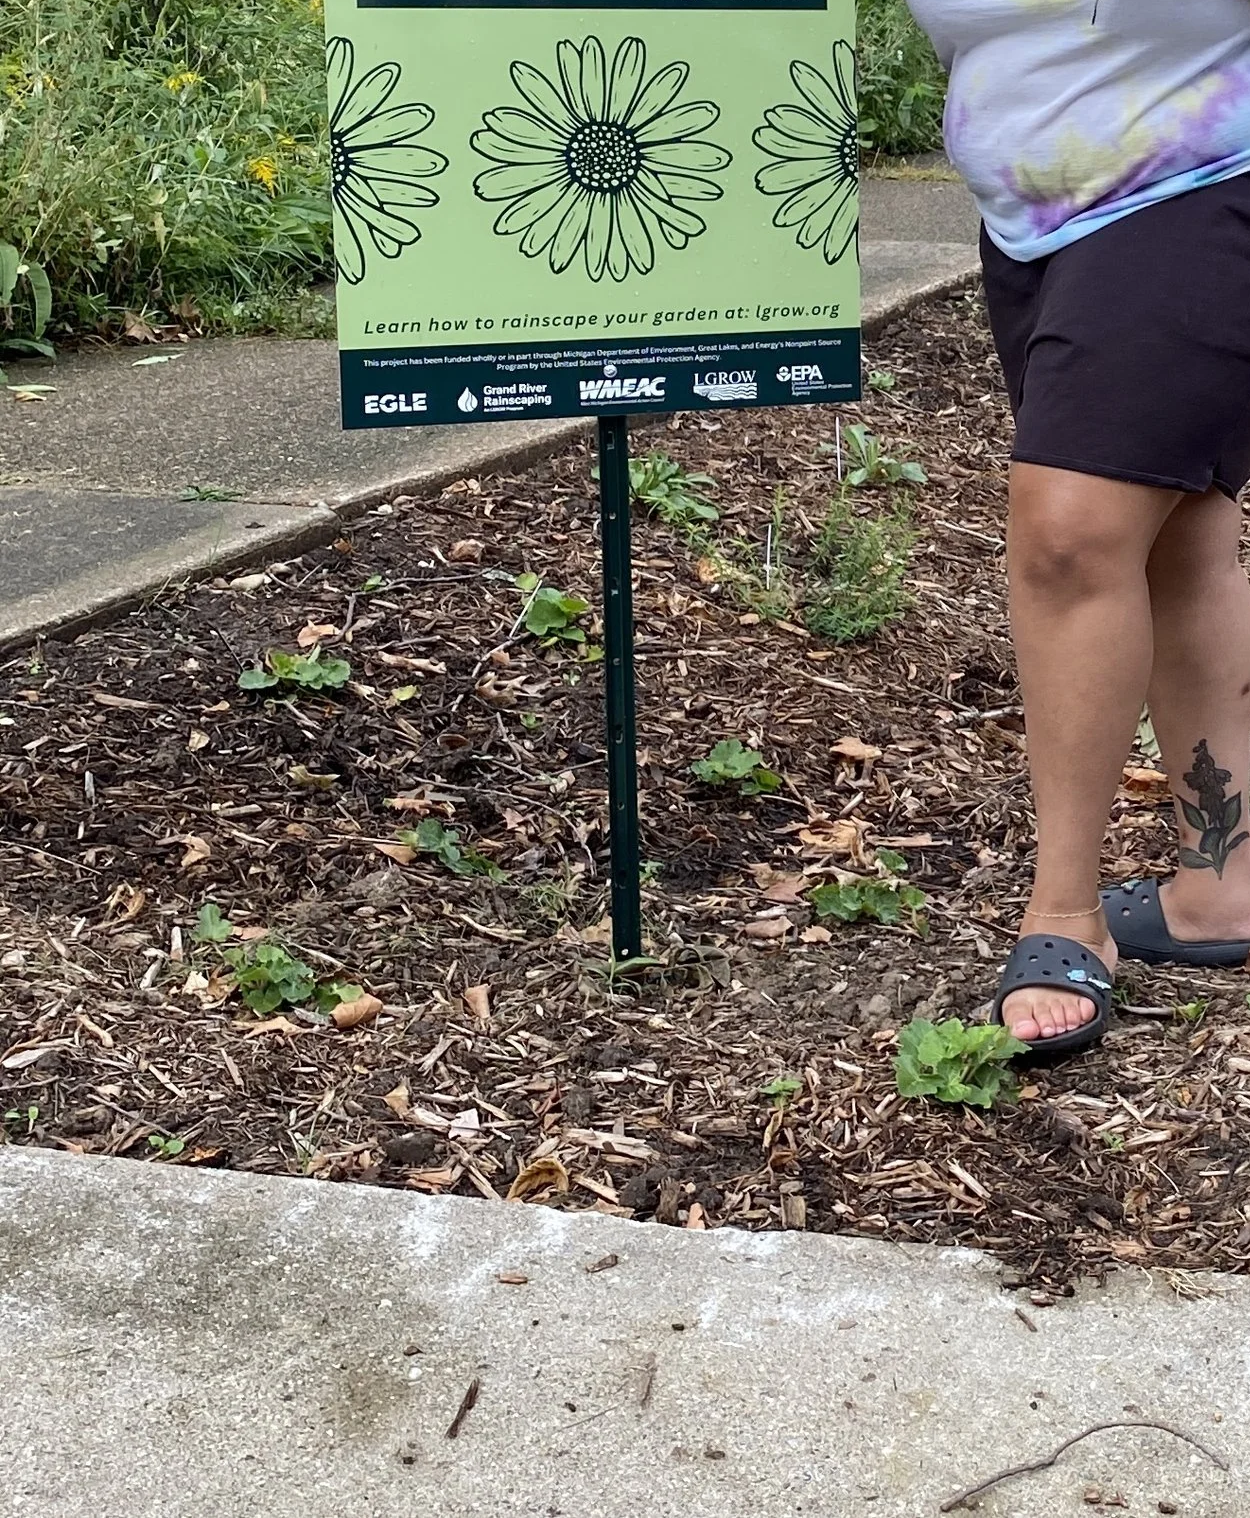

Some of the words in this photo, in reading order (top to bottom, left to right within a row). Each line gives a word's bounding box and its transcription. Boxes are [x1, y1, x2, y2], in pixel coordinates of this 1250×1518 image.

[364, 319, 421, 335] Learn
[428, 317, 469, 332] how
[475, 317, 494, 330] to
[501, 313, 598, 330] rainscape
[602, 312, 648, 329] your
[652, 307, 718, 327] garden
[724, 306, 750, 320] at:
[756, 303, 840, 322] lgrow.org
[363, 359, 380, 367] This
[380, 358, 409, 368] project
[409, 357, 423, 365] has
[423, 357, 444, 365] been
[444, 355, 472, 364] funded
[472, 354, 497, 363] wholly
[507, 353, 515, 361] in
[515, 353, 532, 362] part
[532, 351, 563, 360] through
[563, 350, 596, 359] Michigan
[596, 348, 640, 358] Department
[640, 346, 649, 355] of
[697, 344, 718, 352] Great
[741, 342, 755, 350] and
[496, 361, 529, 372] Program
[529, 362, 539, 371] by
[539, 361, 553, 369] the
[553, 360, 579, 368] United
[579, 358, 603, 367] States
[656, 355, 694, 363] Protection
[791, 364, 824, 381] EPA
[483, 383, 517, 396] Grand
[518, 382, 548, 394] River
[579, 376, 667, 400] WMEAC
[364, 392, 428, 414] EGLE
[483, 394, 552, 407] Rainscaping
